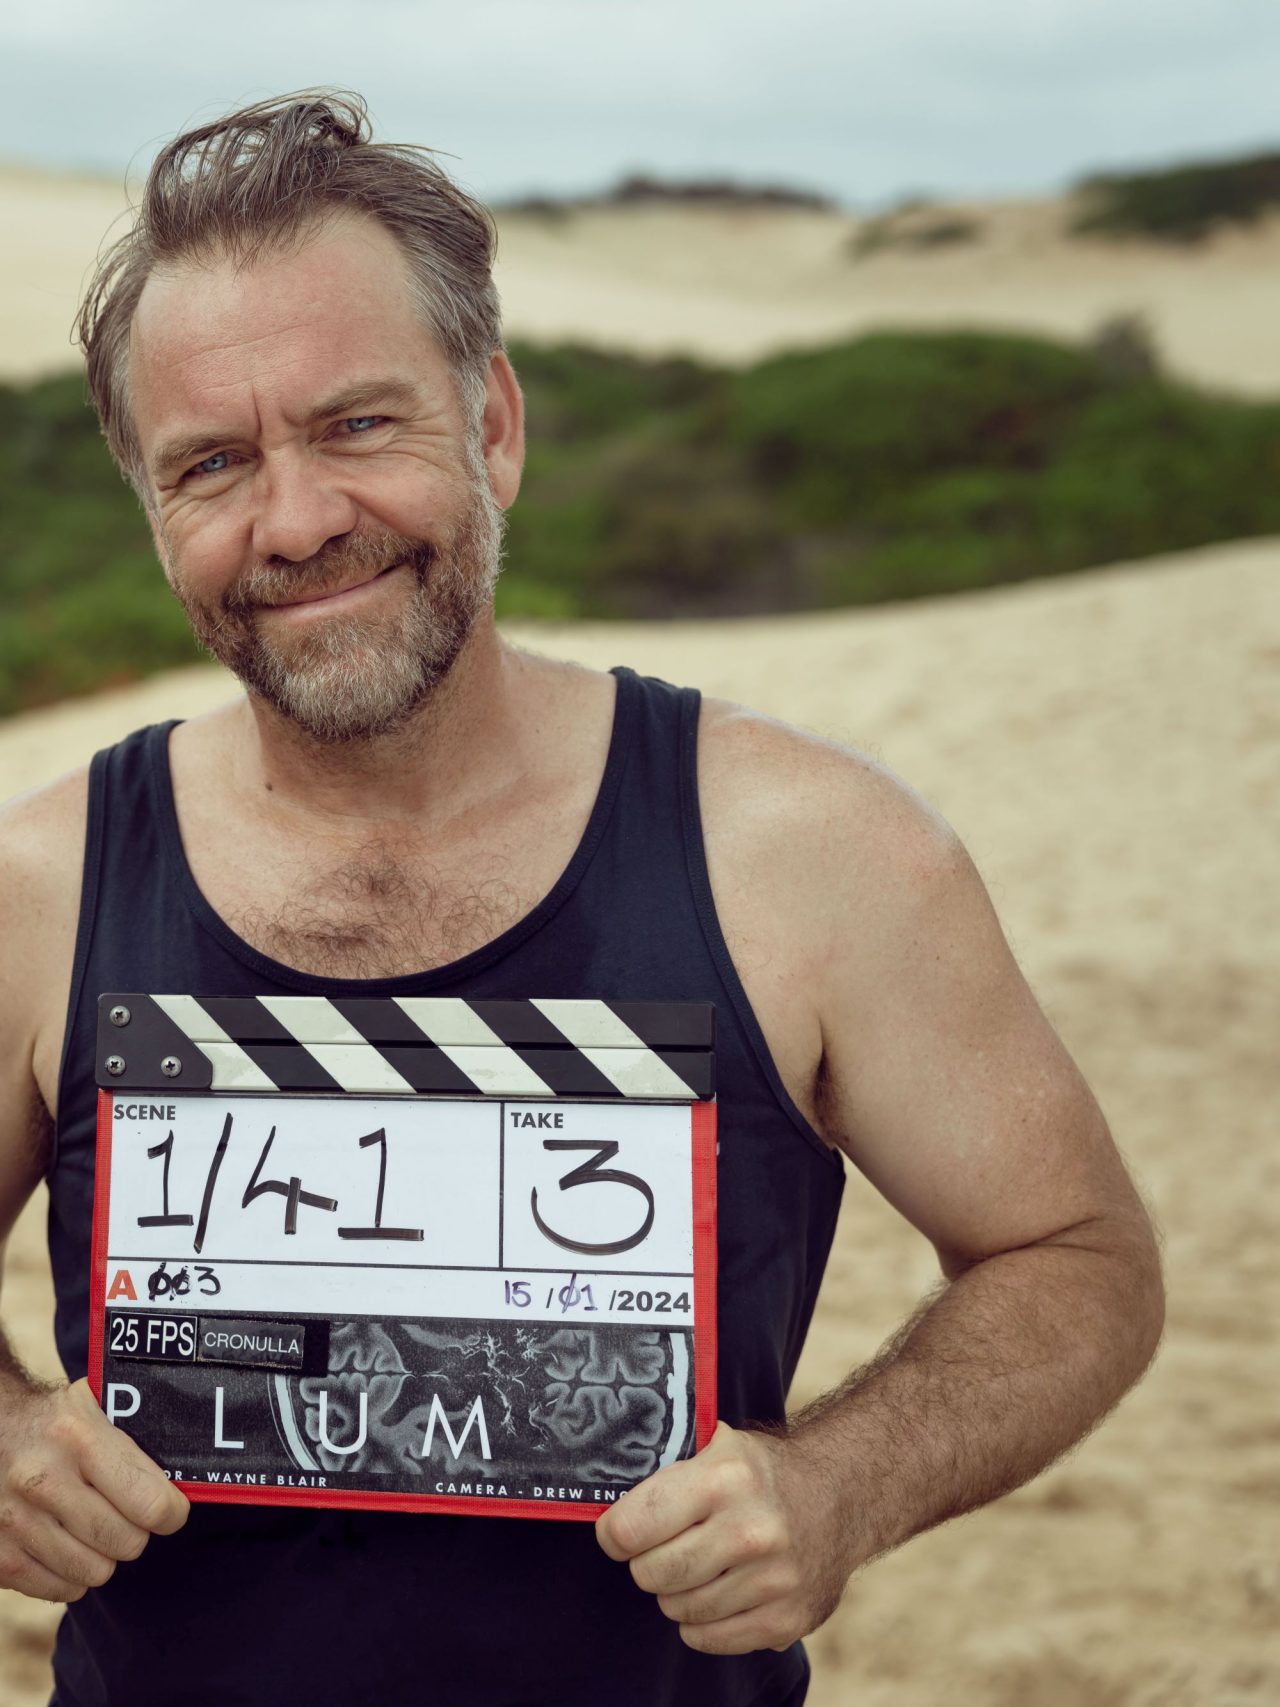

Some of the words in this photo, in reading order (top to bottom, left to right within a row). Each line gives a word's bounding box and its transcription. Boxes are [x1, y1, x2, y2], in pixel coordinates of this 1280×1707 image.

[113, 1103, 177, 1121] SCENE
[510, 1111, 564, 1129] TAKE
[137, 1111, 425, 1255] 1/41
[531, 1139, 655, 1256] 3
[107, 1269, 138, 1301] A
[110, 1317, 140, 1352] 25
[146, 1319, 195, 1356] FPS
[204, 1332, 300, 1355] CRONULLA
[207, 1471, 267, 1485] WAYNE
[277, 1475, 327, 1488] BLAIR
[435, 1482, 508, 1496] CAMERA
[533, 1487, 584, 1500] DREW
